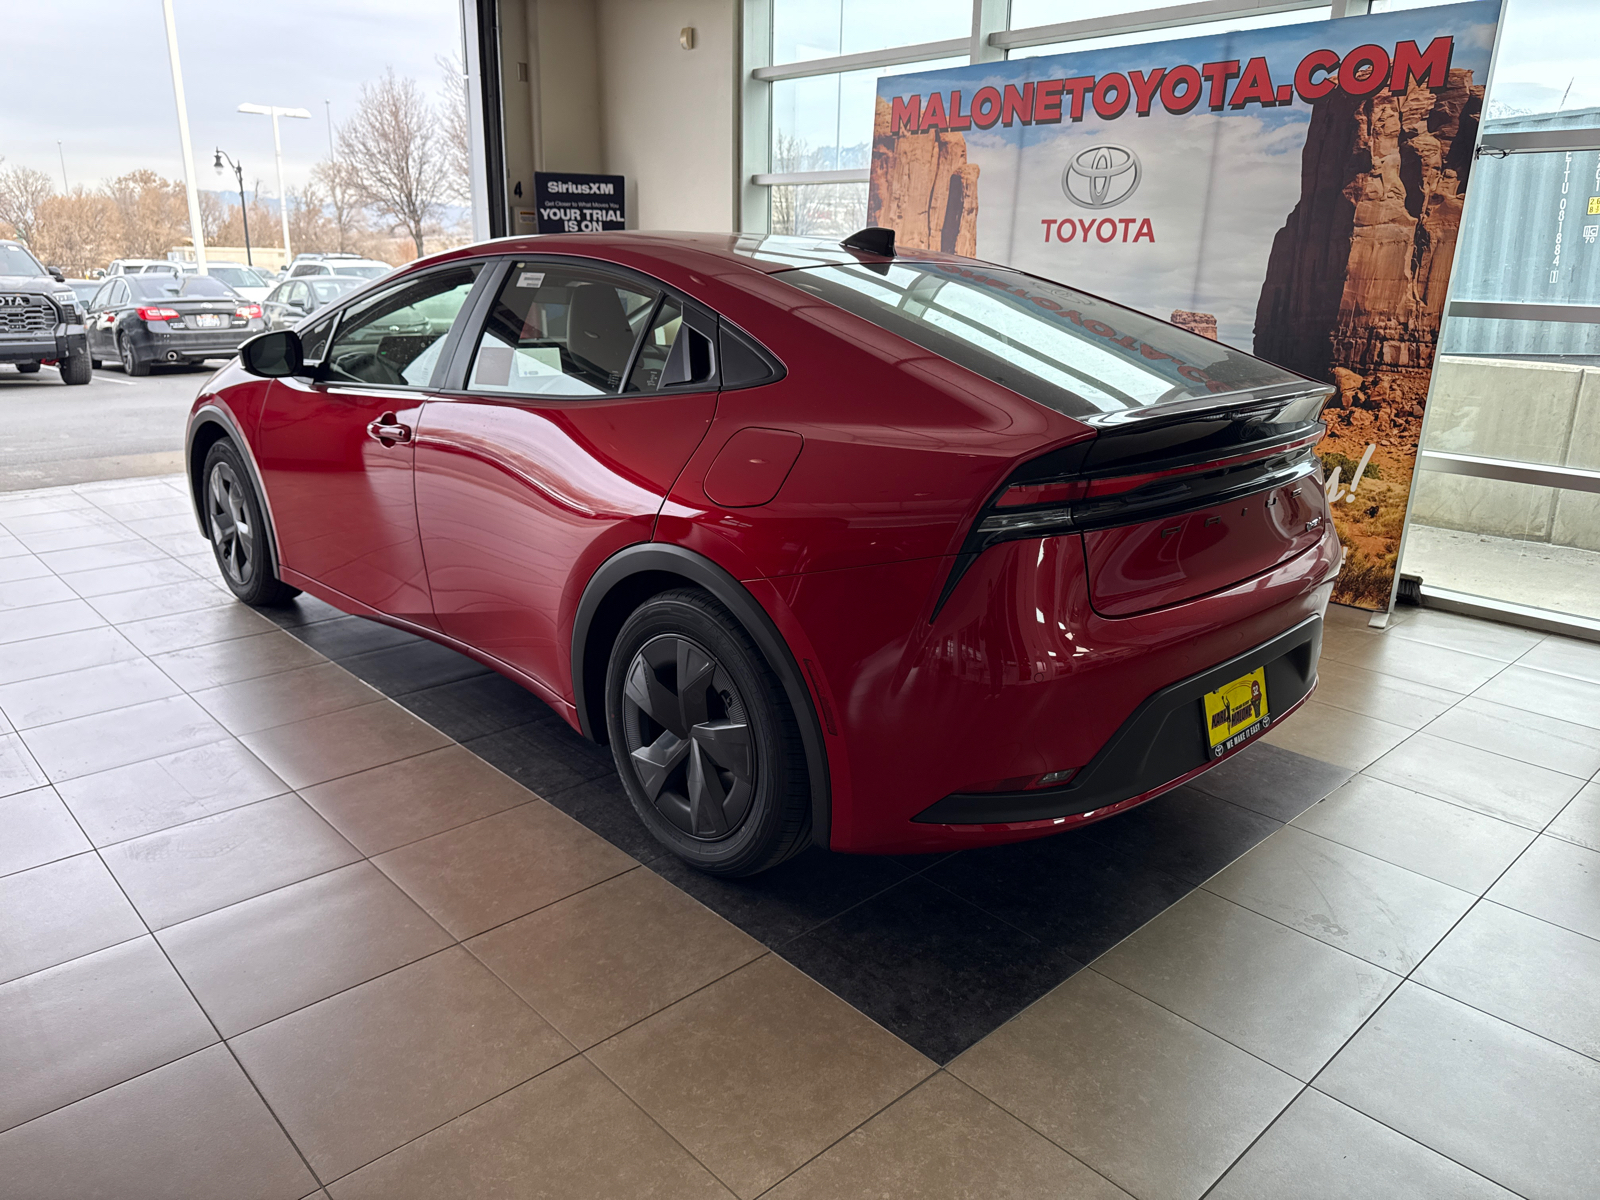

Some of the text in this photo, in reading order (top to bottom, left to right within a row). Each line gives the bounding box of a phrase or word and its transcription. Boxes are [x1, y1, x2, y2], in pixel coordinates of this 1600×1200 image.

[891, 35, 1454, 134] MALONETOYOTA.COM
[514, 181, 522, 199] 4
[547, 181, 614, 195] SiriusXM
[540, 208, 580, 220] YOUR
[583, 209, 625, 222] TRIAL
[564, 221, 602, 232] IS ON
[1041, 218, 1155, 243] TOYOTA
[1252, 685, 1259, 696] 32
[1226, 739, 1234, 749] WE
[1233, 732, 1246, 745] MAKE
[1250, 722, 1260, 735] EASY
